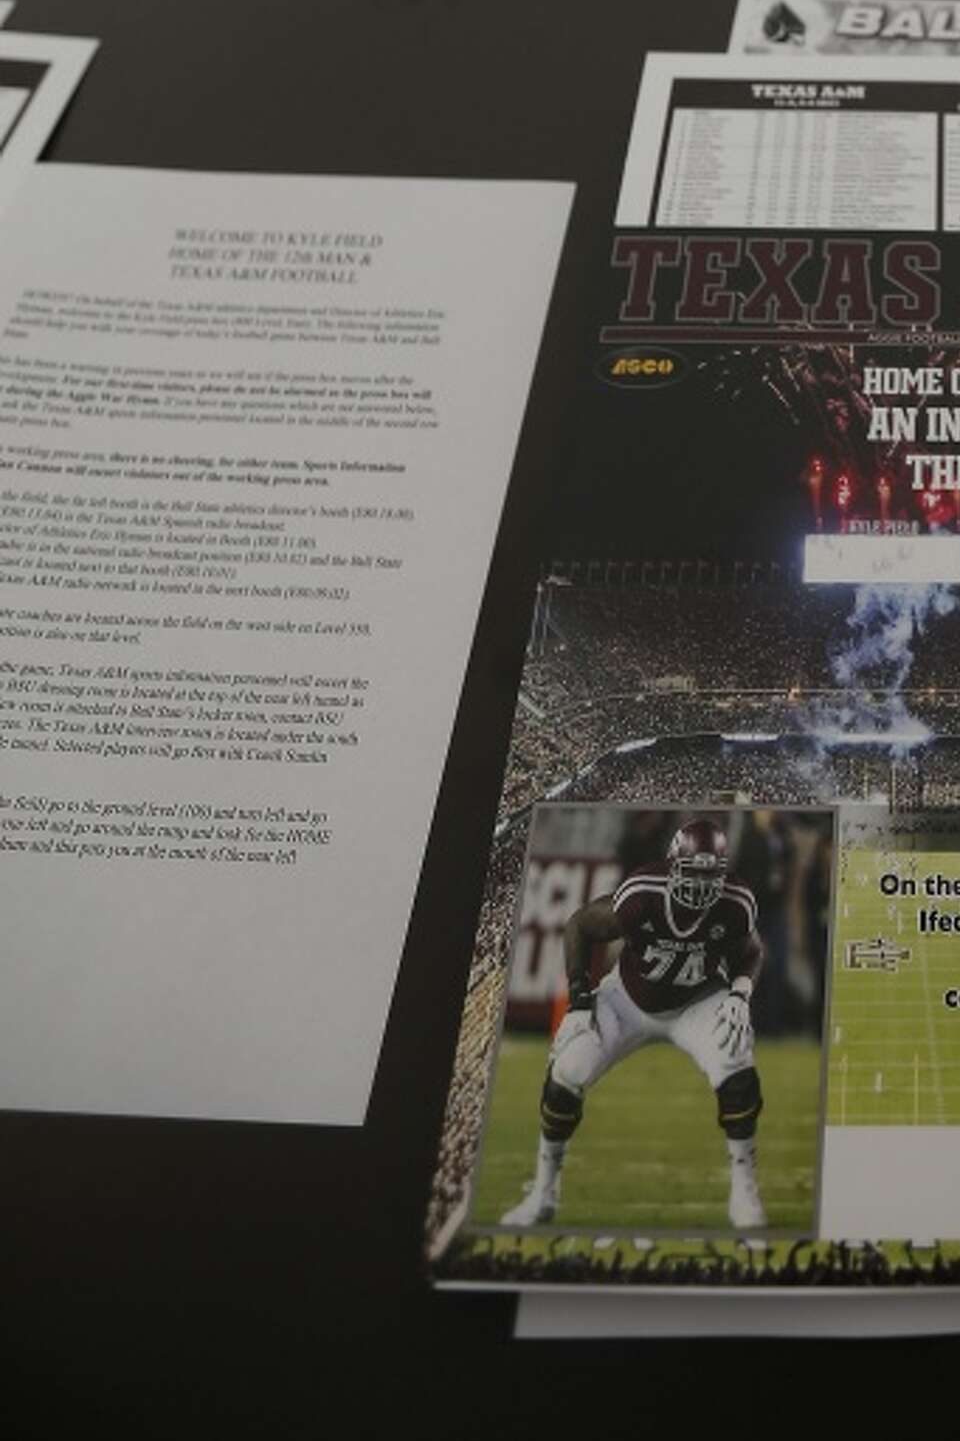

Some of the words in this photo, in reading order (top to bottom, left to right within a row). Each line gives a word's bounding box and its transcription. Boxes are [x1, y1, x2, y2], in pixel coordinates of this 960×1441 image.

[751, 85, 817, 99] TEXAS
[175, 228, 255, 244] WELCOME
[263, 230, 284, 245] TO
[287, 231, 331, 247] KYLE
[333, 231, 384, 248] FIELD
[611, 236, 942, 325] TEXAS
[863, 367, 943, 396] HOME
[867, 407, 918, 441] AN
[880, 874, 915, 896] On
[642, 945, 707, 986] 74
